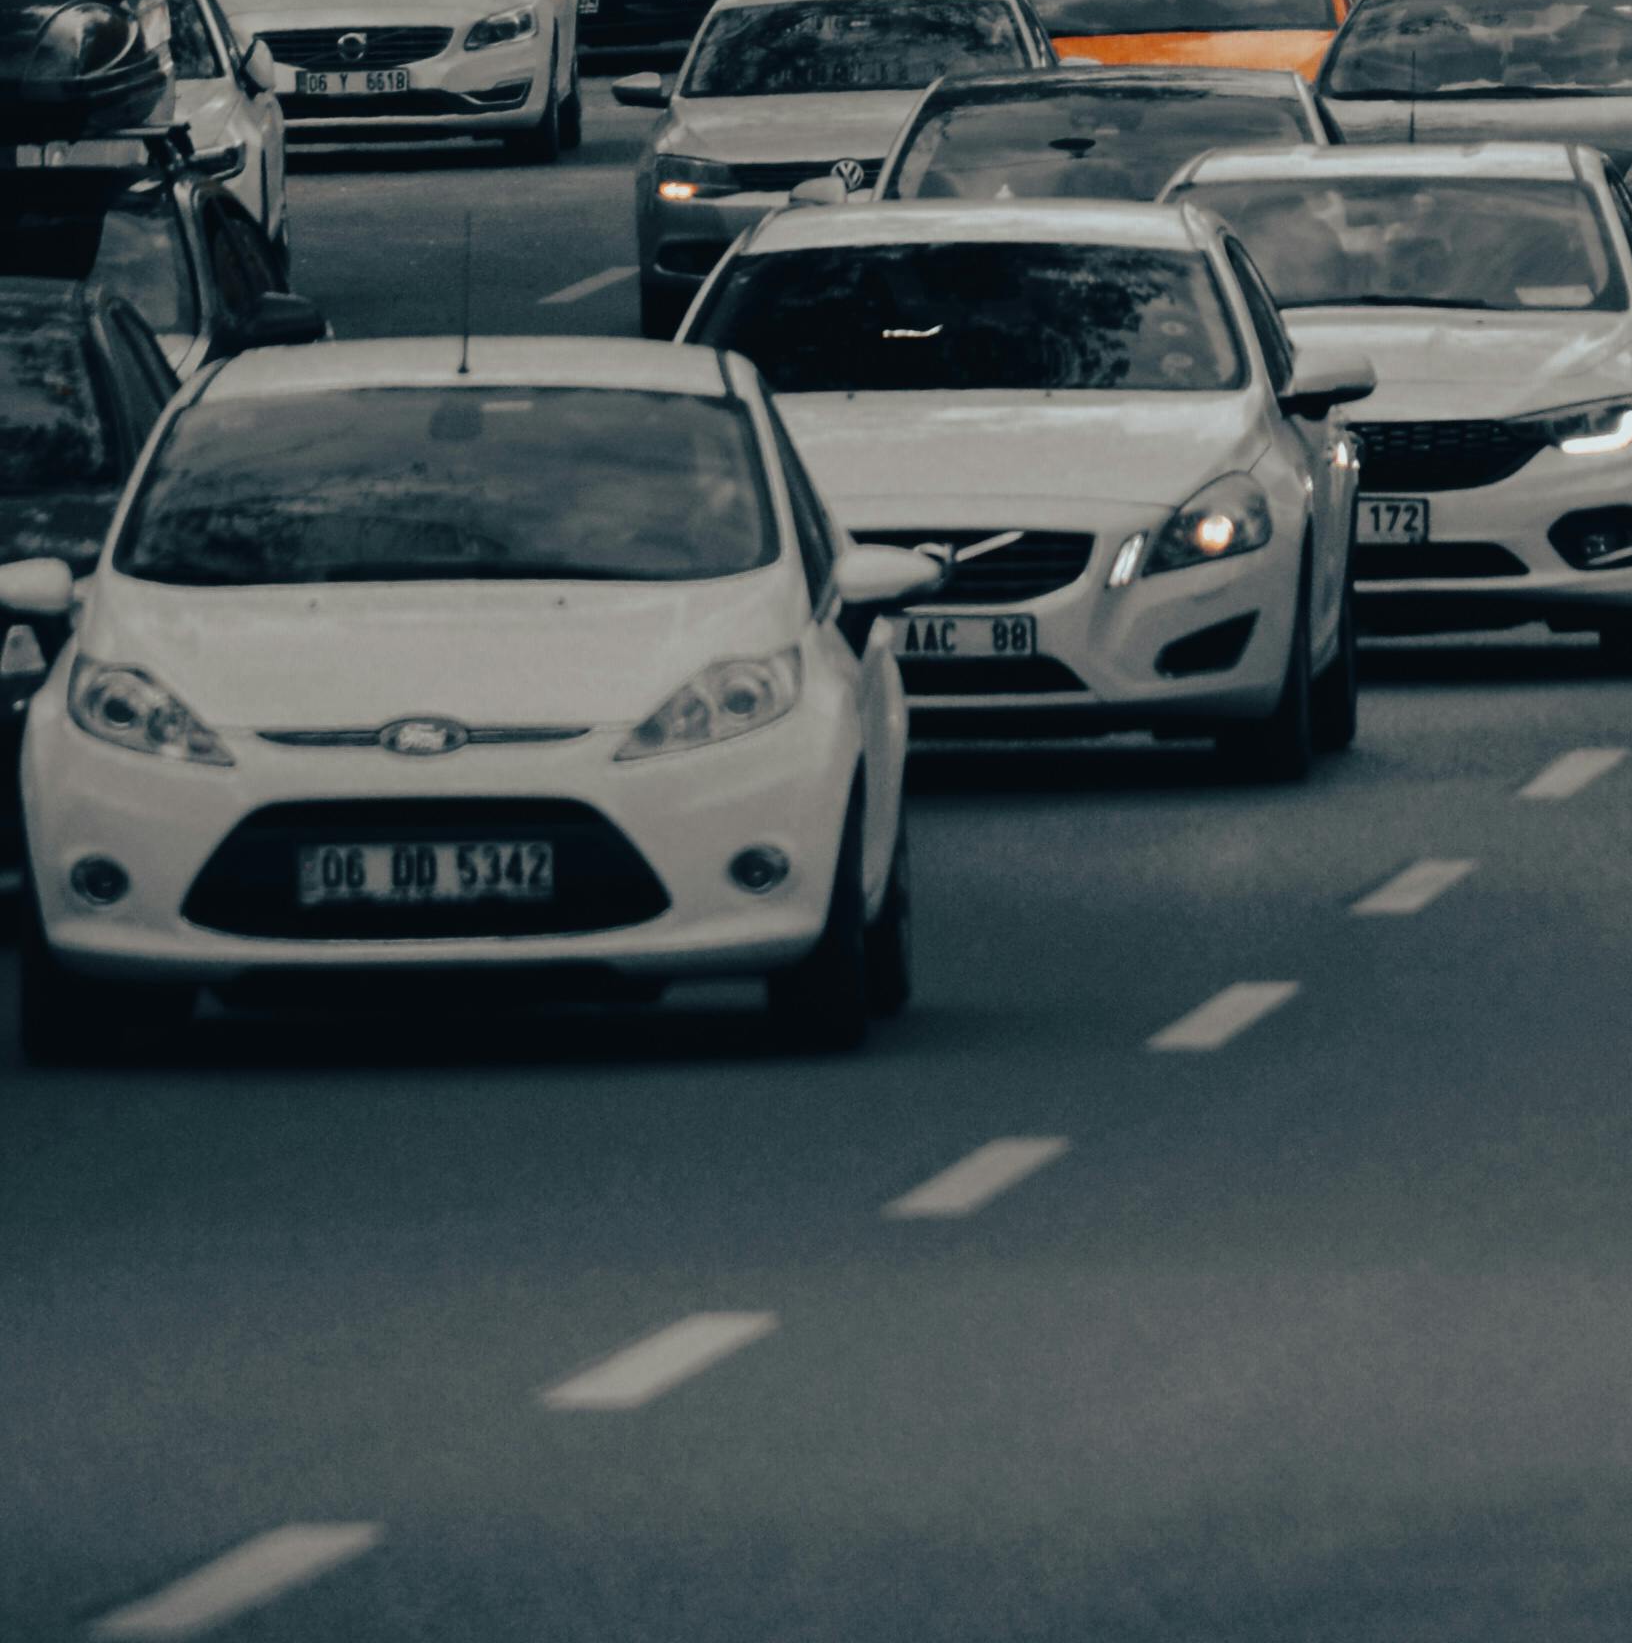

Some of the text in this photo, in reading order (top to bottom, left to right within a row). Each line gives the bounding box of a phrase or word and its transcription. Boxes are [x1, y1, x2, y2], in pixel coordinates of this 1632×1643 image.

[308, 75, 327, 92] 06
[1370, 504, 1419, 532] 172
[904, 617, 956, 652] AAC
[322, 845, 365, 888] 06
